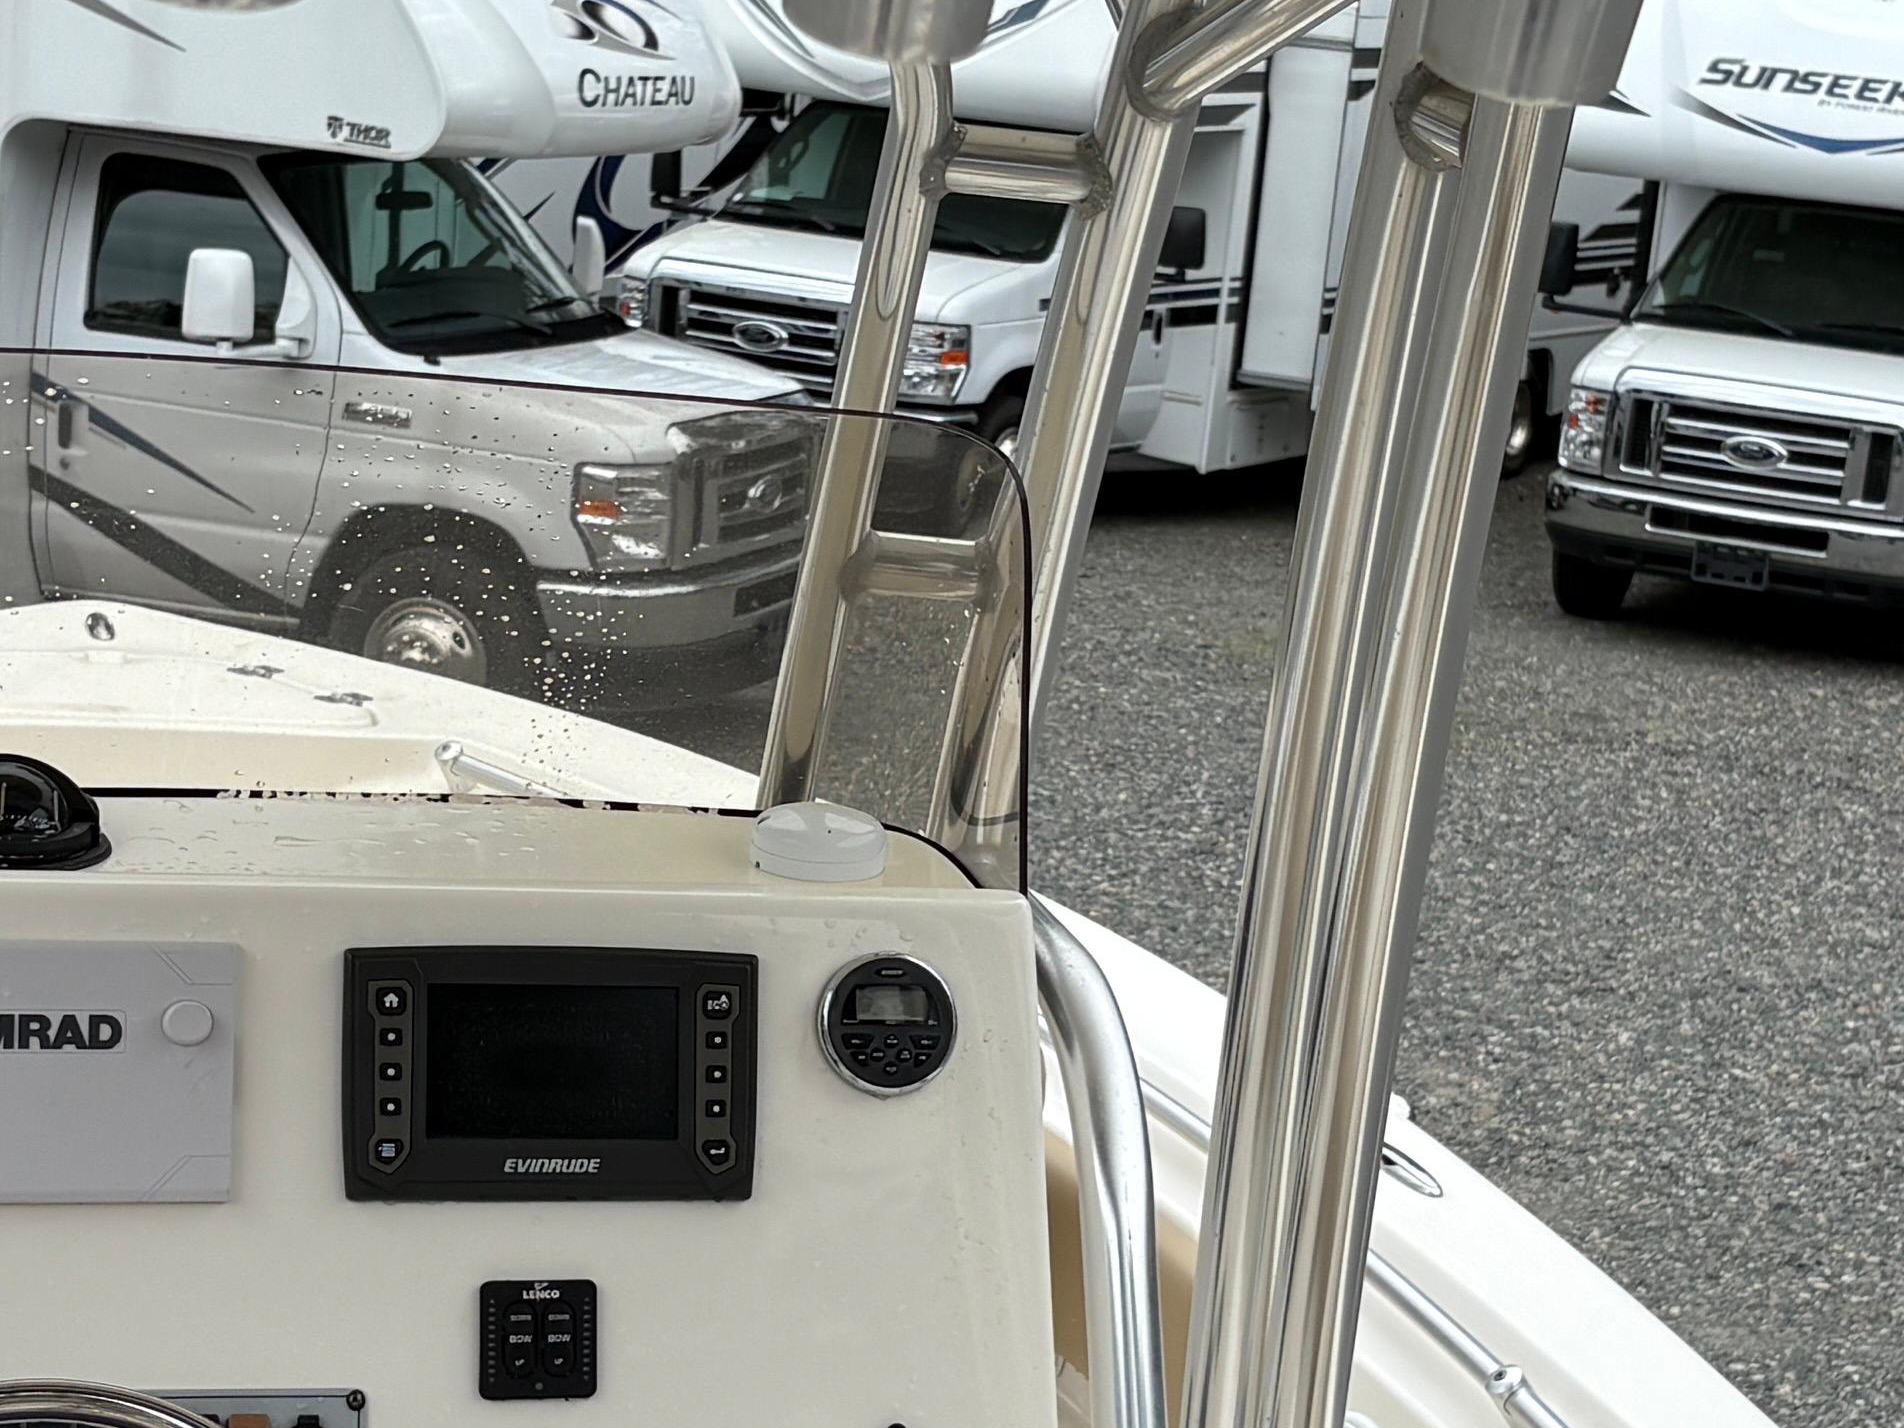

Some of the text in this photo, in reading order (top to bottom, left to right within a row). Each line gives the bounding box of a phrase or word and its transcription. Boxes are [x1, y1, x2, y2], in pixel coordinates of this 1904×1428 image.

[578, 67, 696, 108] CHATEAU
[503, 1158, 601, 1173] EVINRUDE
[522, 1290, 560, 1300] LENCO
